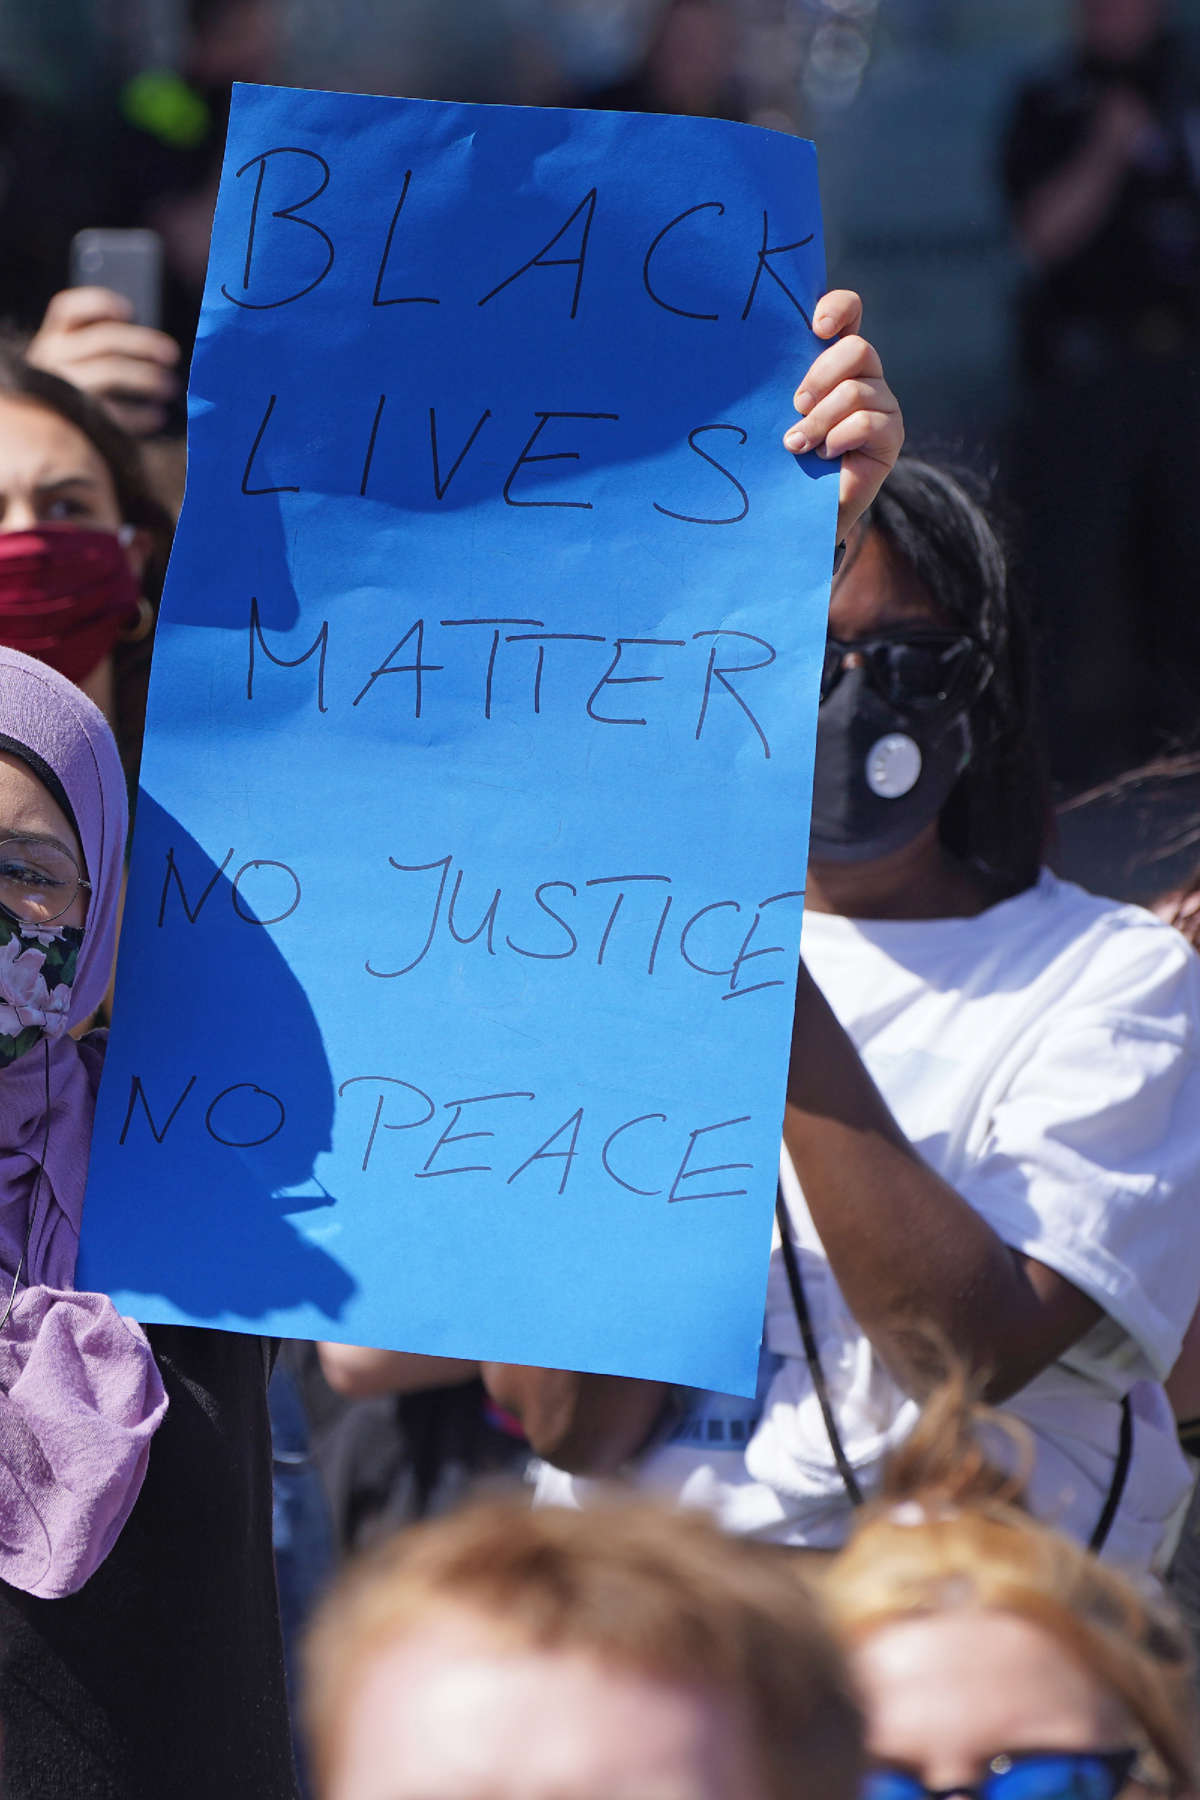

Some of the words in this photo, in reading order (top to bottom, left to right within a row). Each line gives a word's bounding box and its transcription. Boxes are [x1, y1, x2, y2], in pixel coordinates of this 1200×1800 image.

[220, 146, 815, 331] BLACK
[241, 394, 750, 525] LIVES
[247, 597, 777, 759] MATTER
[157, 847, 302, 928] NO
[365, 855, 806, 1000] JUSTICE
[119, 1075, 286, 1147] NO
[338, 1075, 754, 1203] PEACE
